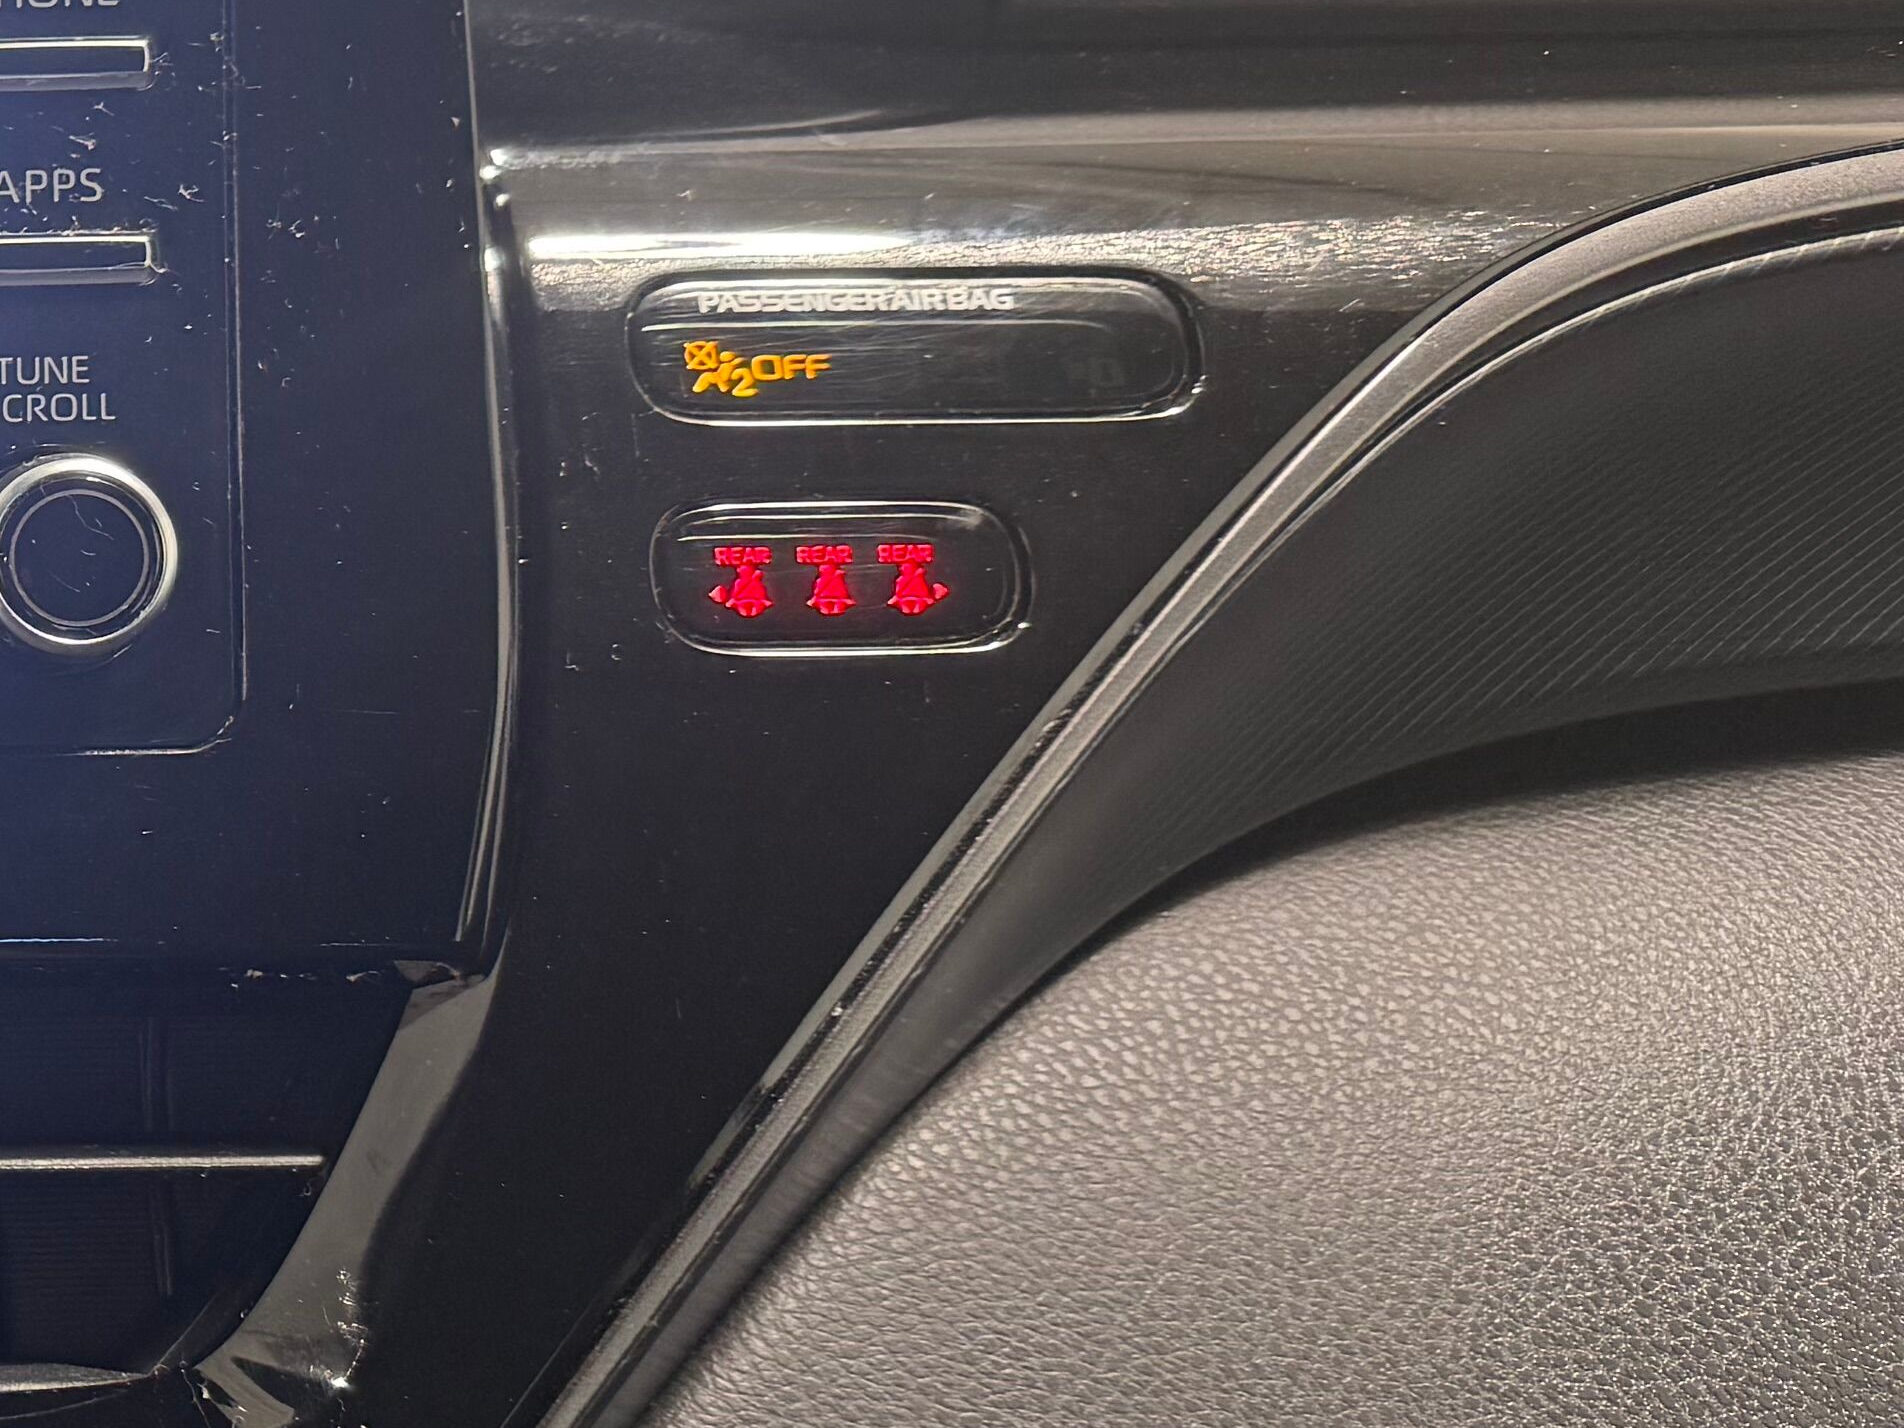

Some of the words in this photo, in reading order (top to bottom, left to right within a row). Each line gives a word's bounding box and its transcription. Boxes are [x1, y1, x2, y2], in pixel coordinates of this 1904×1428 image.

[697, 291, 891, 314] PASSENGER
[714, 546, 772, 566] REAR
[795, 545, 853, 565] REAR
[877, 543, 935, 564] REAR
